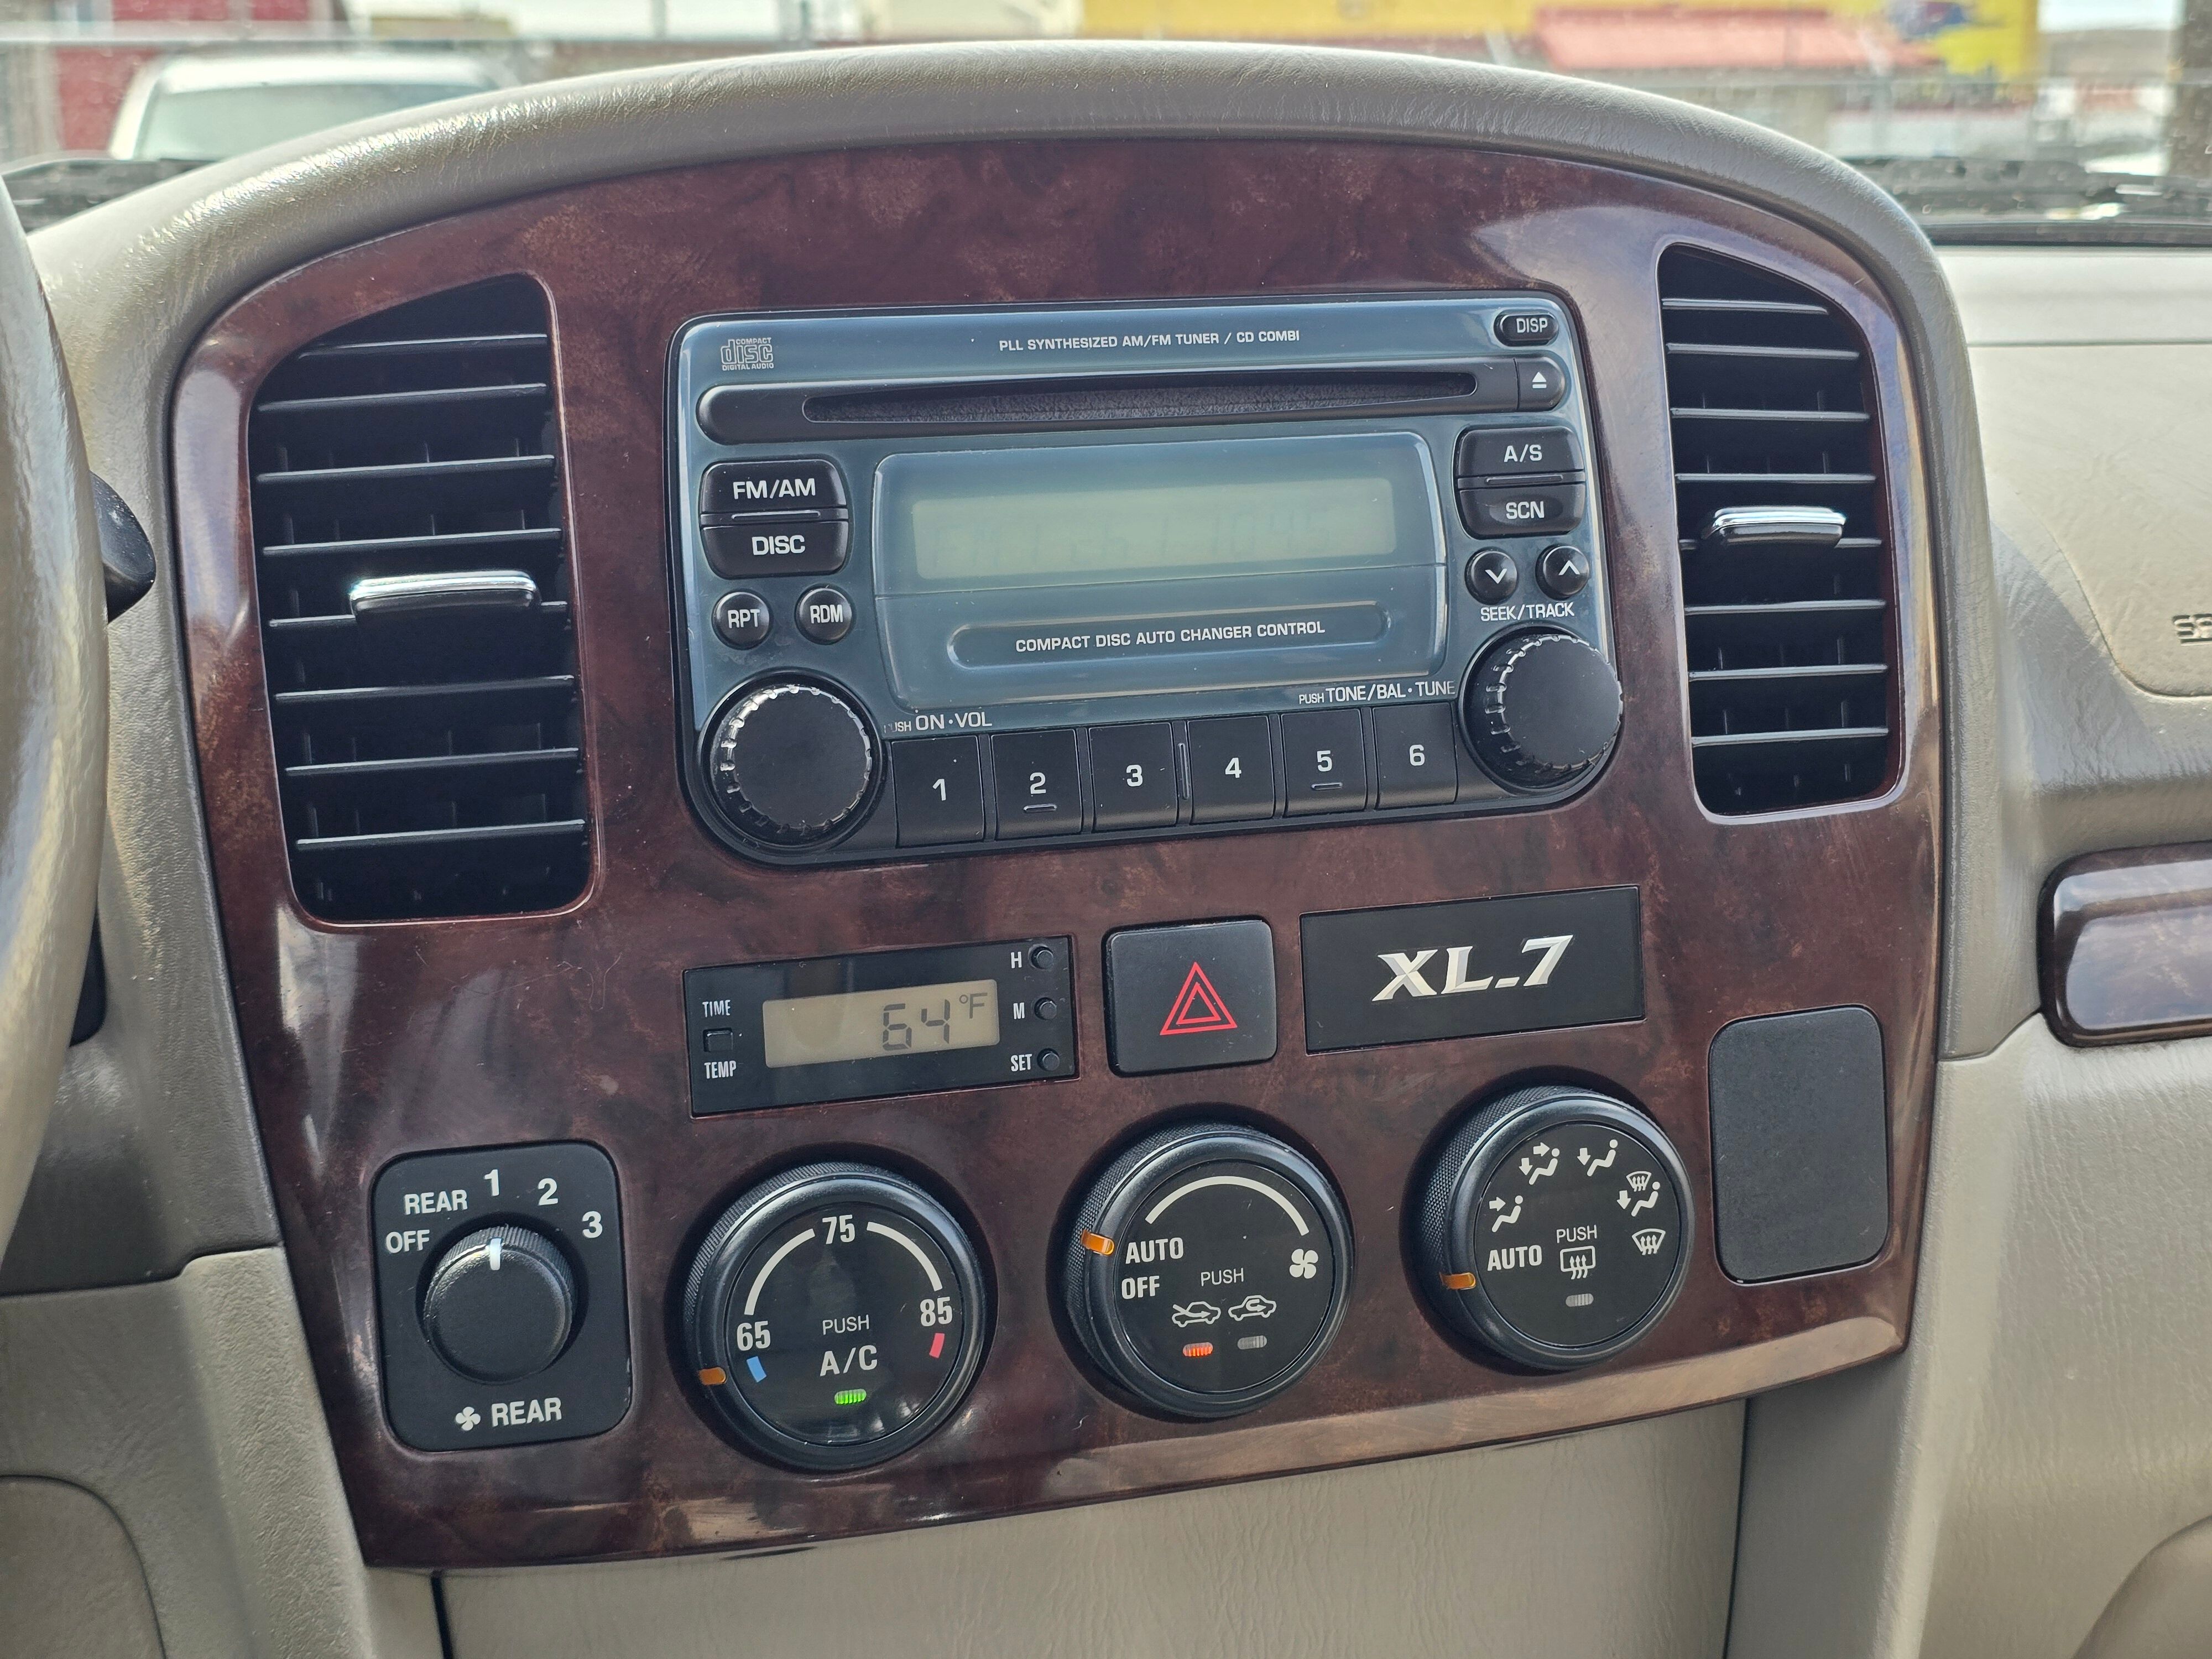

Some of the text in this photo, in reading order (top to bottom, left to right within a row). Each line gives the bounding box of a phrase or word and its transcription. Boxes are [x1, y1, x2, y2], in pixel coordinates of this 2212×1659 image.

[1516, 317, 1548, 333] DISP
[999, 340, 1024, 351] PLL
[1027, 336, 1118, 350] SYNTHESIZED
[1122, 334, 1171, 348] AM/FM
[1175, 333, 1219, 345] TUNER
[1236, 331, 1254, 343] CD
[1258, 330, 1300, 342] COMBI
[1504, 444, 1542, 462] A/S
[733, 478, 816, 500] FM/AM
[1505, 500, 1545, 520] SCN
[752, 535, 806, 555] DISC
[727, 608, 760, 629] RPT
[810, 604, 843, 624] RDM
[1480, 602, 1575, 622] SEEK/TRACK
[1016, 621, 1326, 652] COMPACT DISC AUTO CHANGER CONTROL
[1298, 692, 1324, 705] PUSH
[1317, 750, 1333, 772] 5
[1409, 744, 1425, 766] 6
[1126, 764, 1143, 787] 3
[1225, 757, 1242, 779] 4
[932, 778, 946, 801] 1
[1030, 772, 1046, 794] 2
[1010, 951, 1022, 969] H
[702, 999, 731, 1018] TIME
[1013, 1002, 1025, 1020] M
[704, 1060, 737, 1079] TEMP
[1010, 1053, 1032, 1072] SET
[483, 1169, 499, 1196] 1
[537, 1178, 559, 1206] 2
[404, 1189, 468, 1215] REAR
[582, 1211, 603, 1238] 3
[822, 1214, 855, 1245] 75
[1556, 1224, 1598, 1244] PUSH
[385, 1229, 430, 1254] OFF
[1125, 1237, 1184, 1264] AUTO
[1487, 1244, 1542, 1271] AUTO
[1121, 1275, 1160, 1300] OFF
[1201, 1267, 1244, 1287] PUSH
[920, 1296, 953, 1327] 85
[822, 1314, 869, 1335] PUSH
[737, 1321, 771, 1351] 65
[820, 1344, 878, 1376] A/C
[491, 1397, 562, 1427] REAR
